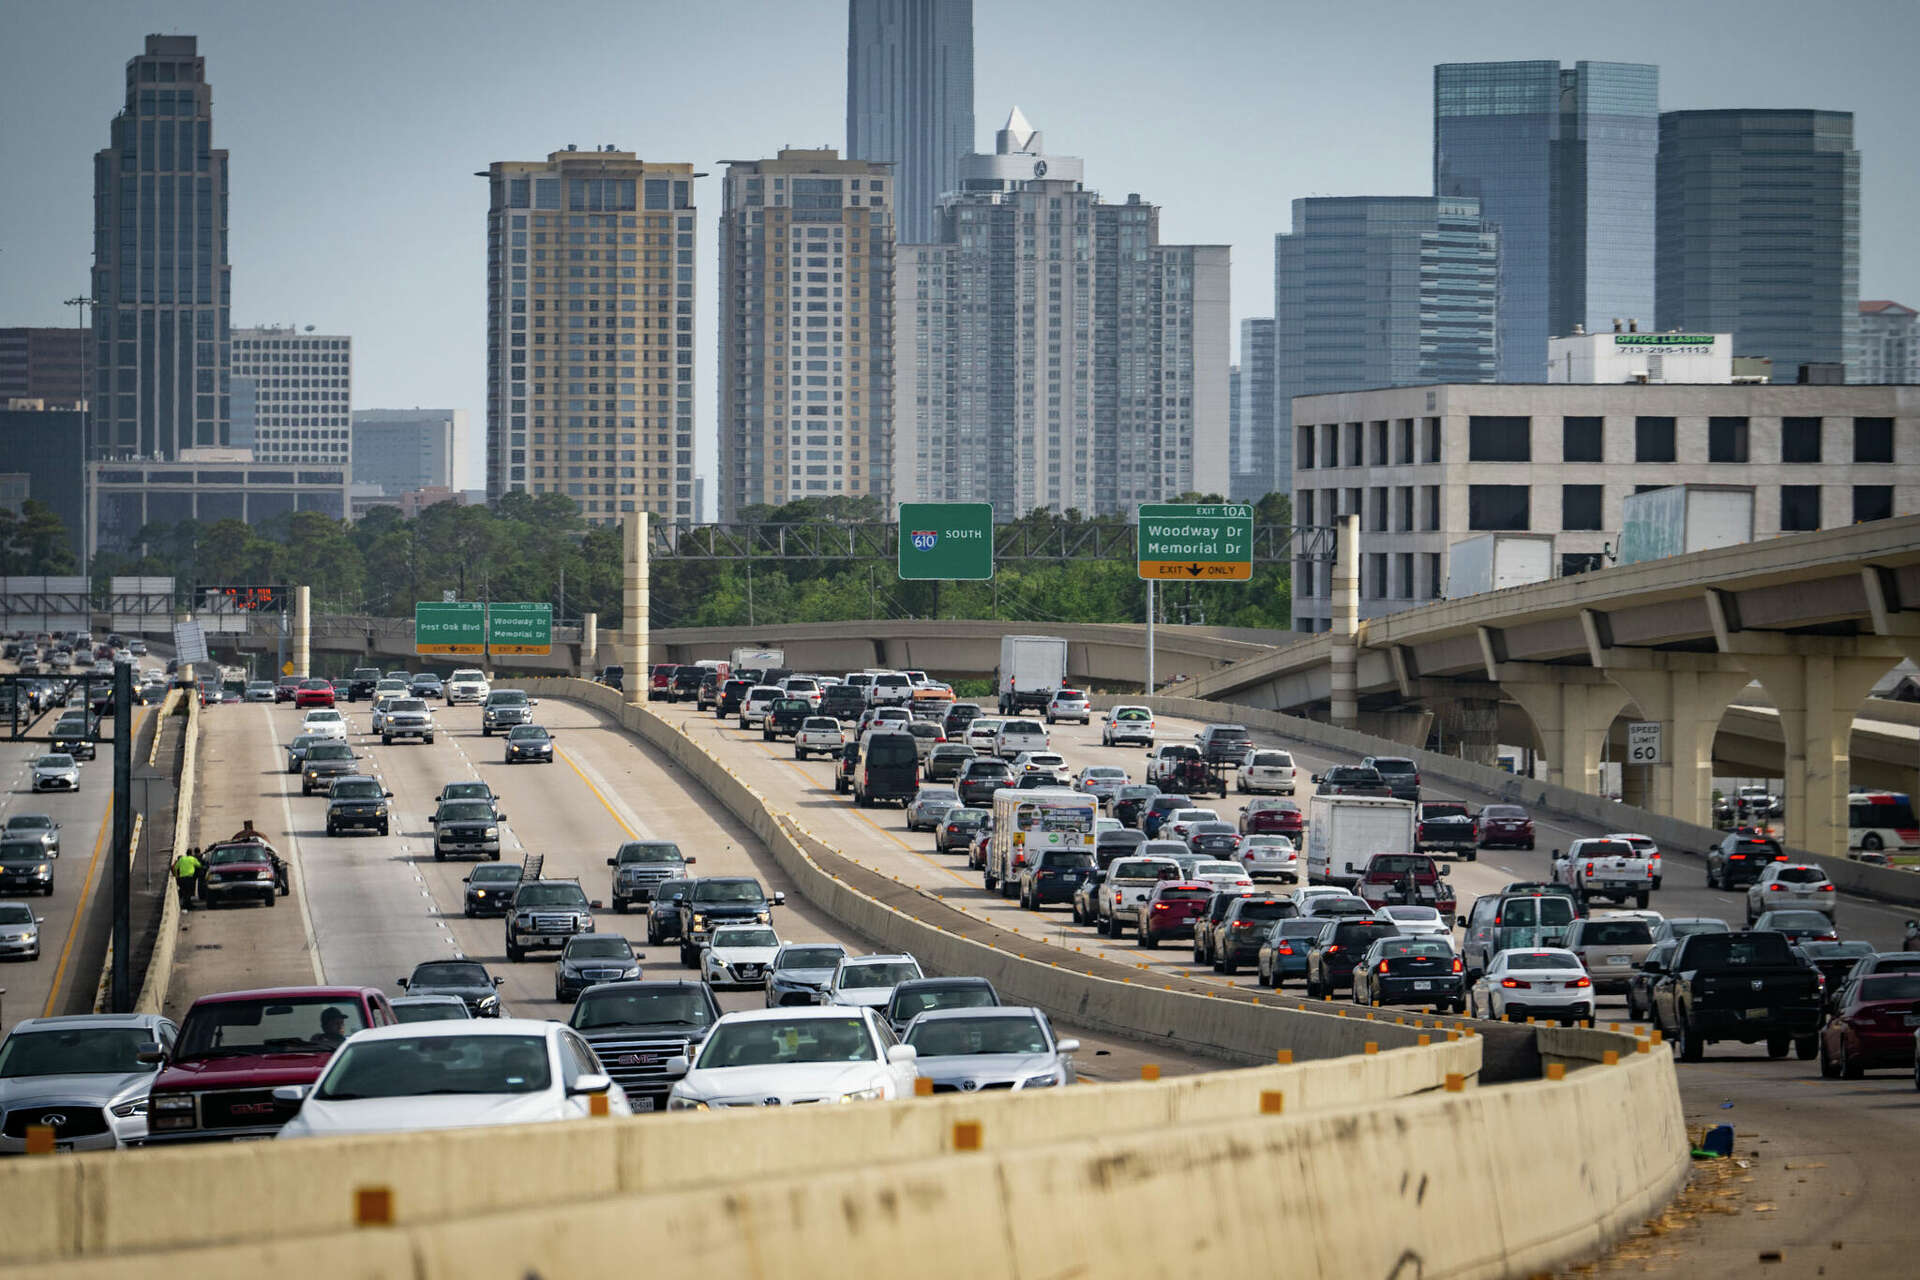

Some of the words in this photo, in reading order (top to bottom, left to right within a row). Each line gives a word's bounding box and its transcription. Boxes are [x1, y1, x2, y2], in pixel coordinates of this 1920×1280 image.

[1617, 336, 1659, 344] OFFICE
[1661, 336, 1713, 344] LEASING
[1619, 346, 1709, 354] 713-295-1113
[1196, 507, 1217, 516] EXIT
[1222, 506, 1247, 517] 10A
[1148, 525, 1219, 540] Woodway
[1226, 526, 1243, 537] Dr
[915, 535, 935, 548] 610
[945, 529, 982, 539] SOUTH
[1148, 542, 1218, 554] Memorial
[1225, 543, 1241, 554] Dr
[1159, 565, 1184, 575] EXIT
[1207, 565, 1236, 575] ONLY
[1631, 726, 1659, 734] SPEED
[1632, 736, 1657, 744] LIMIT
[1633, 746, 1656, 760] 60
[618, 1053, 658, 1065] GMC
[230, 1102, 274, 1115] GMC
